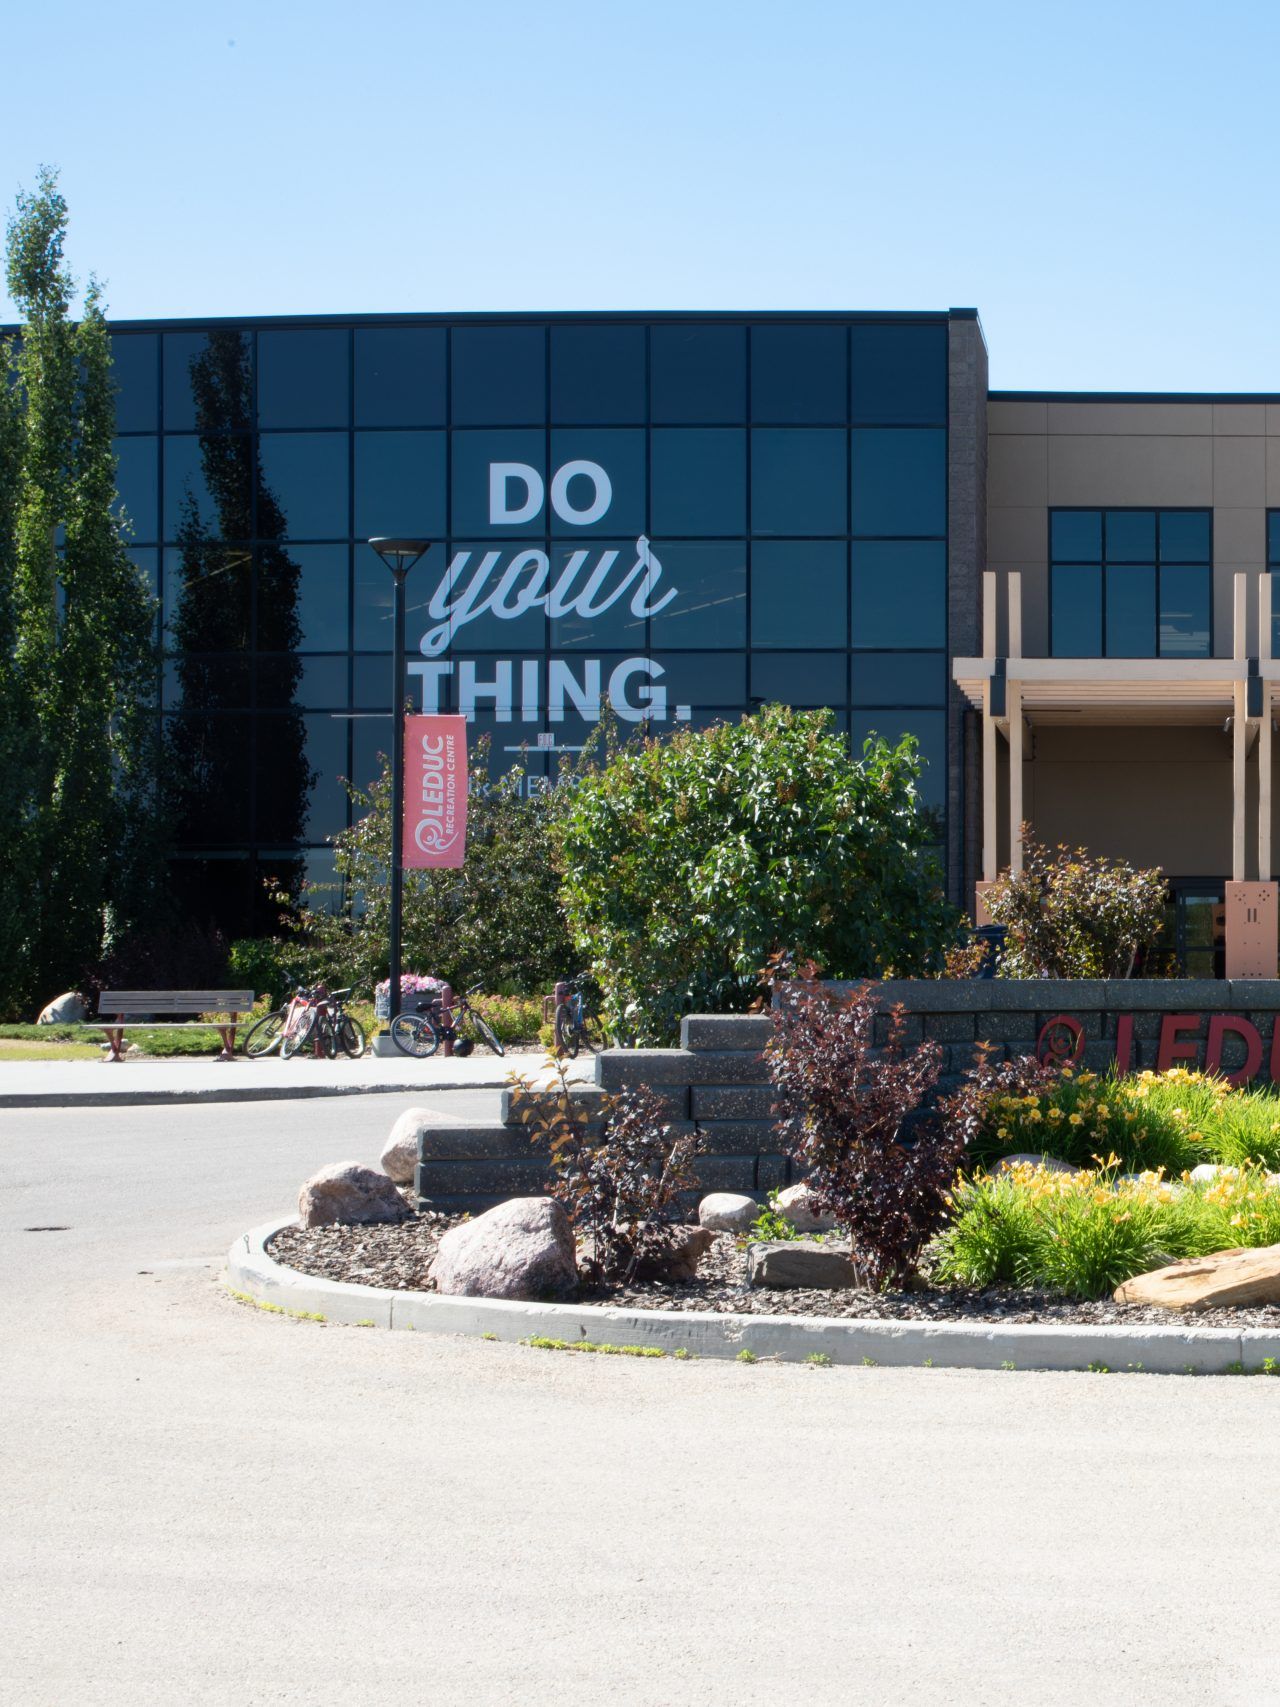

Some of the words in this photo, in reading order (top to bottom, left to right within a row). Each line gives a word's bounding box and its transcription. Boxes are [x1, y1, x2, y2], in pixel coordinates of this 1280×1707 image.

[489, 460, 612, 525] DO
[420, 534, 679, 657] your
[407, 657, 691, 722] THING.
[422, 734, 445, 816] LEDUC
[446, 735, 455, 770] CENTRE
[446, 774, 456, 834] RECREATION
